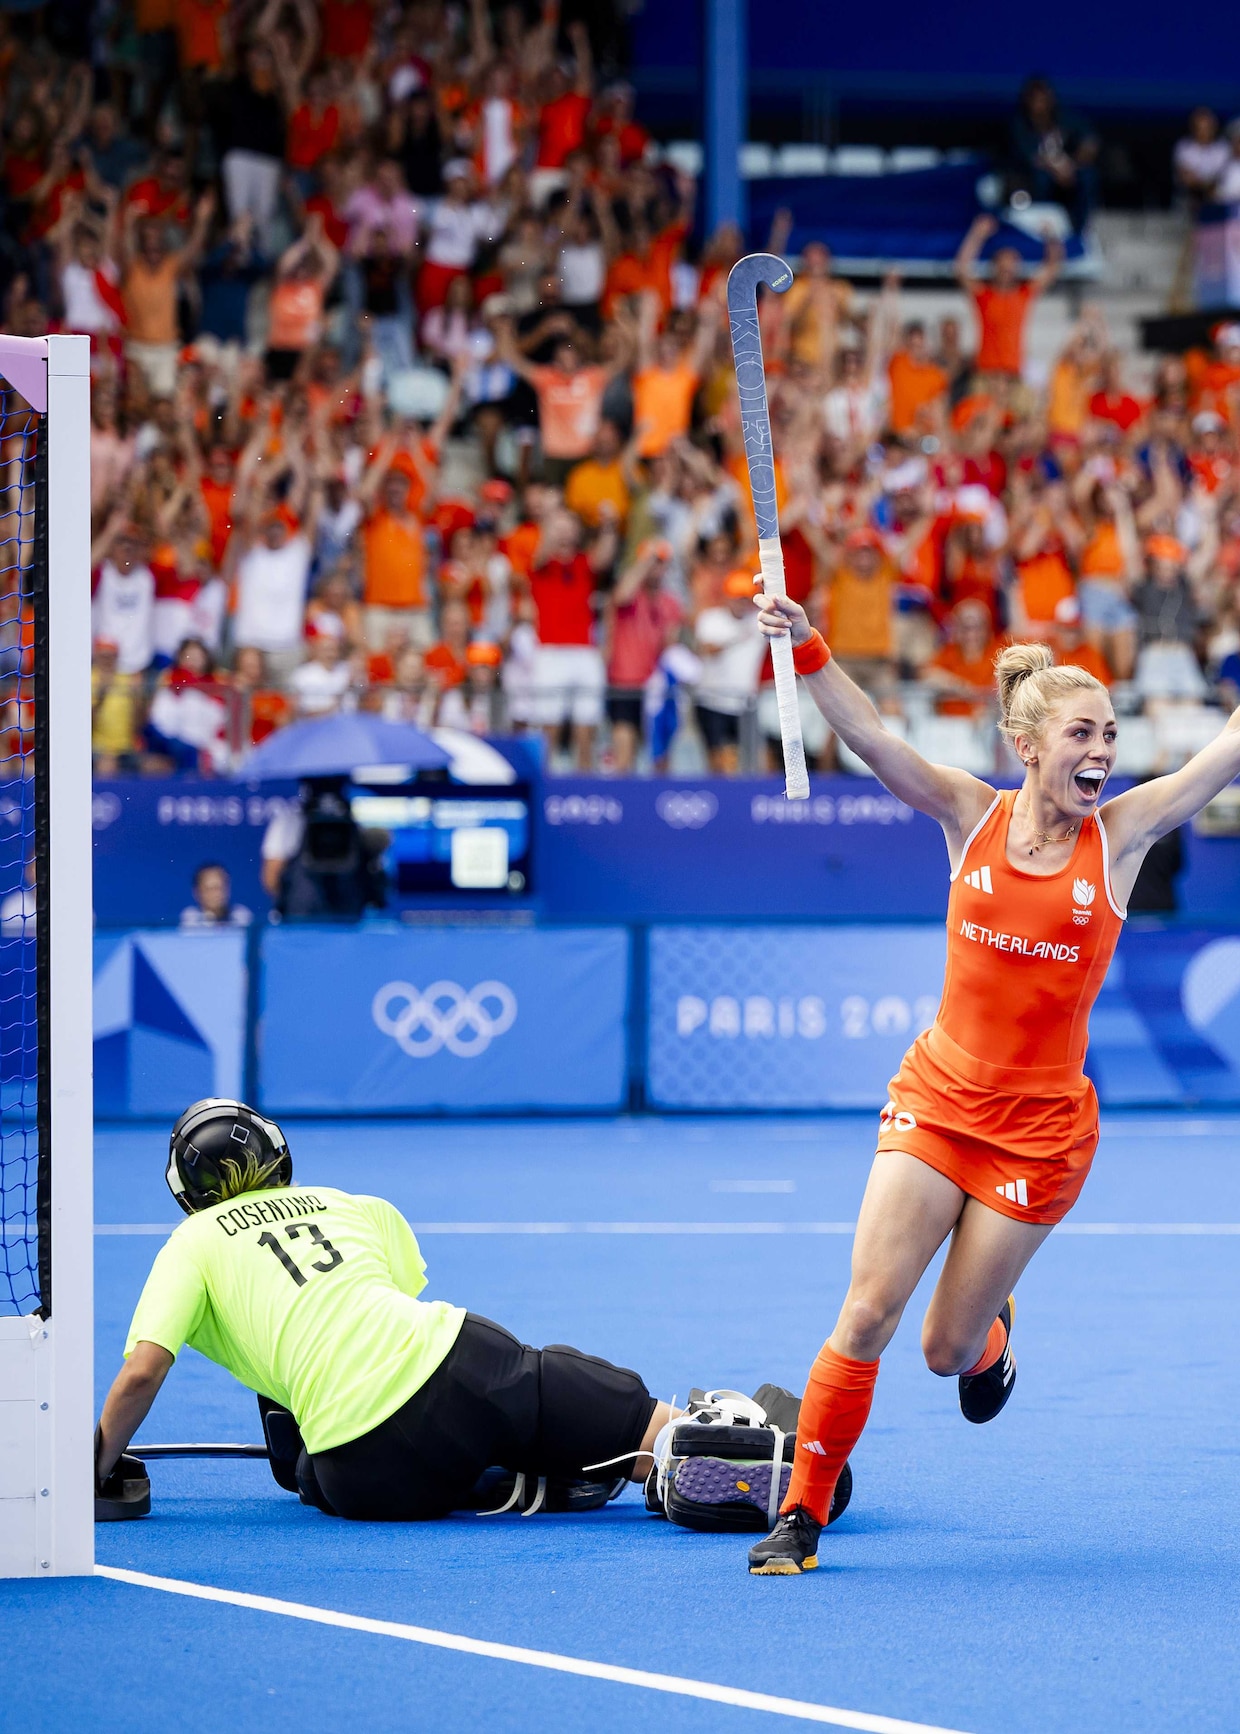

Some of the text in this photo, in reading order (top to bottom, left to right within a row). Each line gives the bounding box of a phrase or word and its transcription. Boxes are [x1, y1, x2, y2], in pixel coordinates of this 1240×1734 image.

[157, 795, 243, 827] PARIS
[544, 794, 623, 826] 2024
[751, 794, 835, 826] PARIS
[960, 919, 1080, 963] NETHERLANDS
[677, 995, 944, 1040] PARIS 202
[216, 1195, 328, 1236] COSENTINO
[257, 1223, 344, 1287] 13
